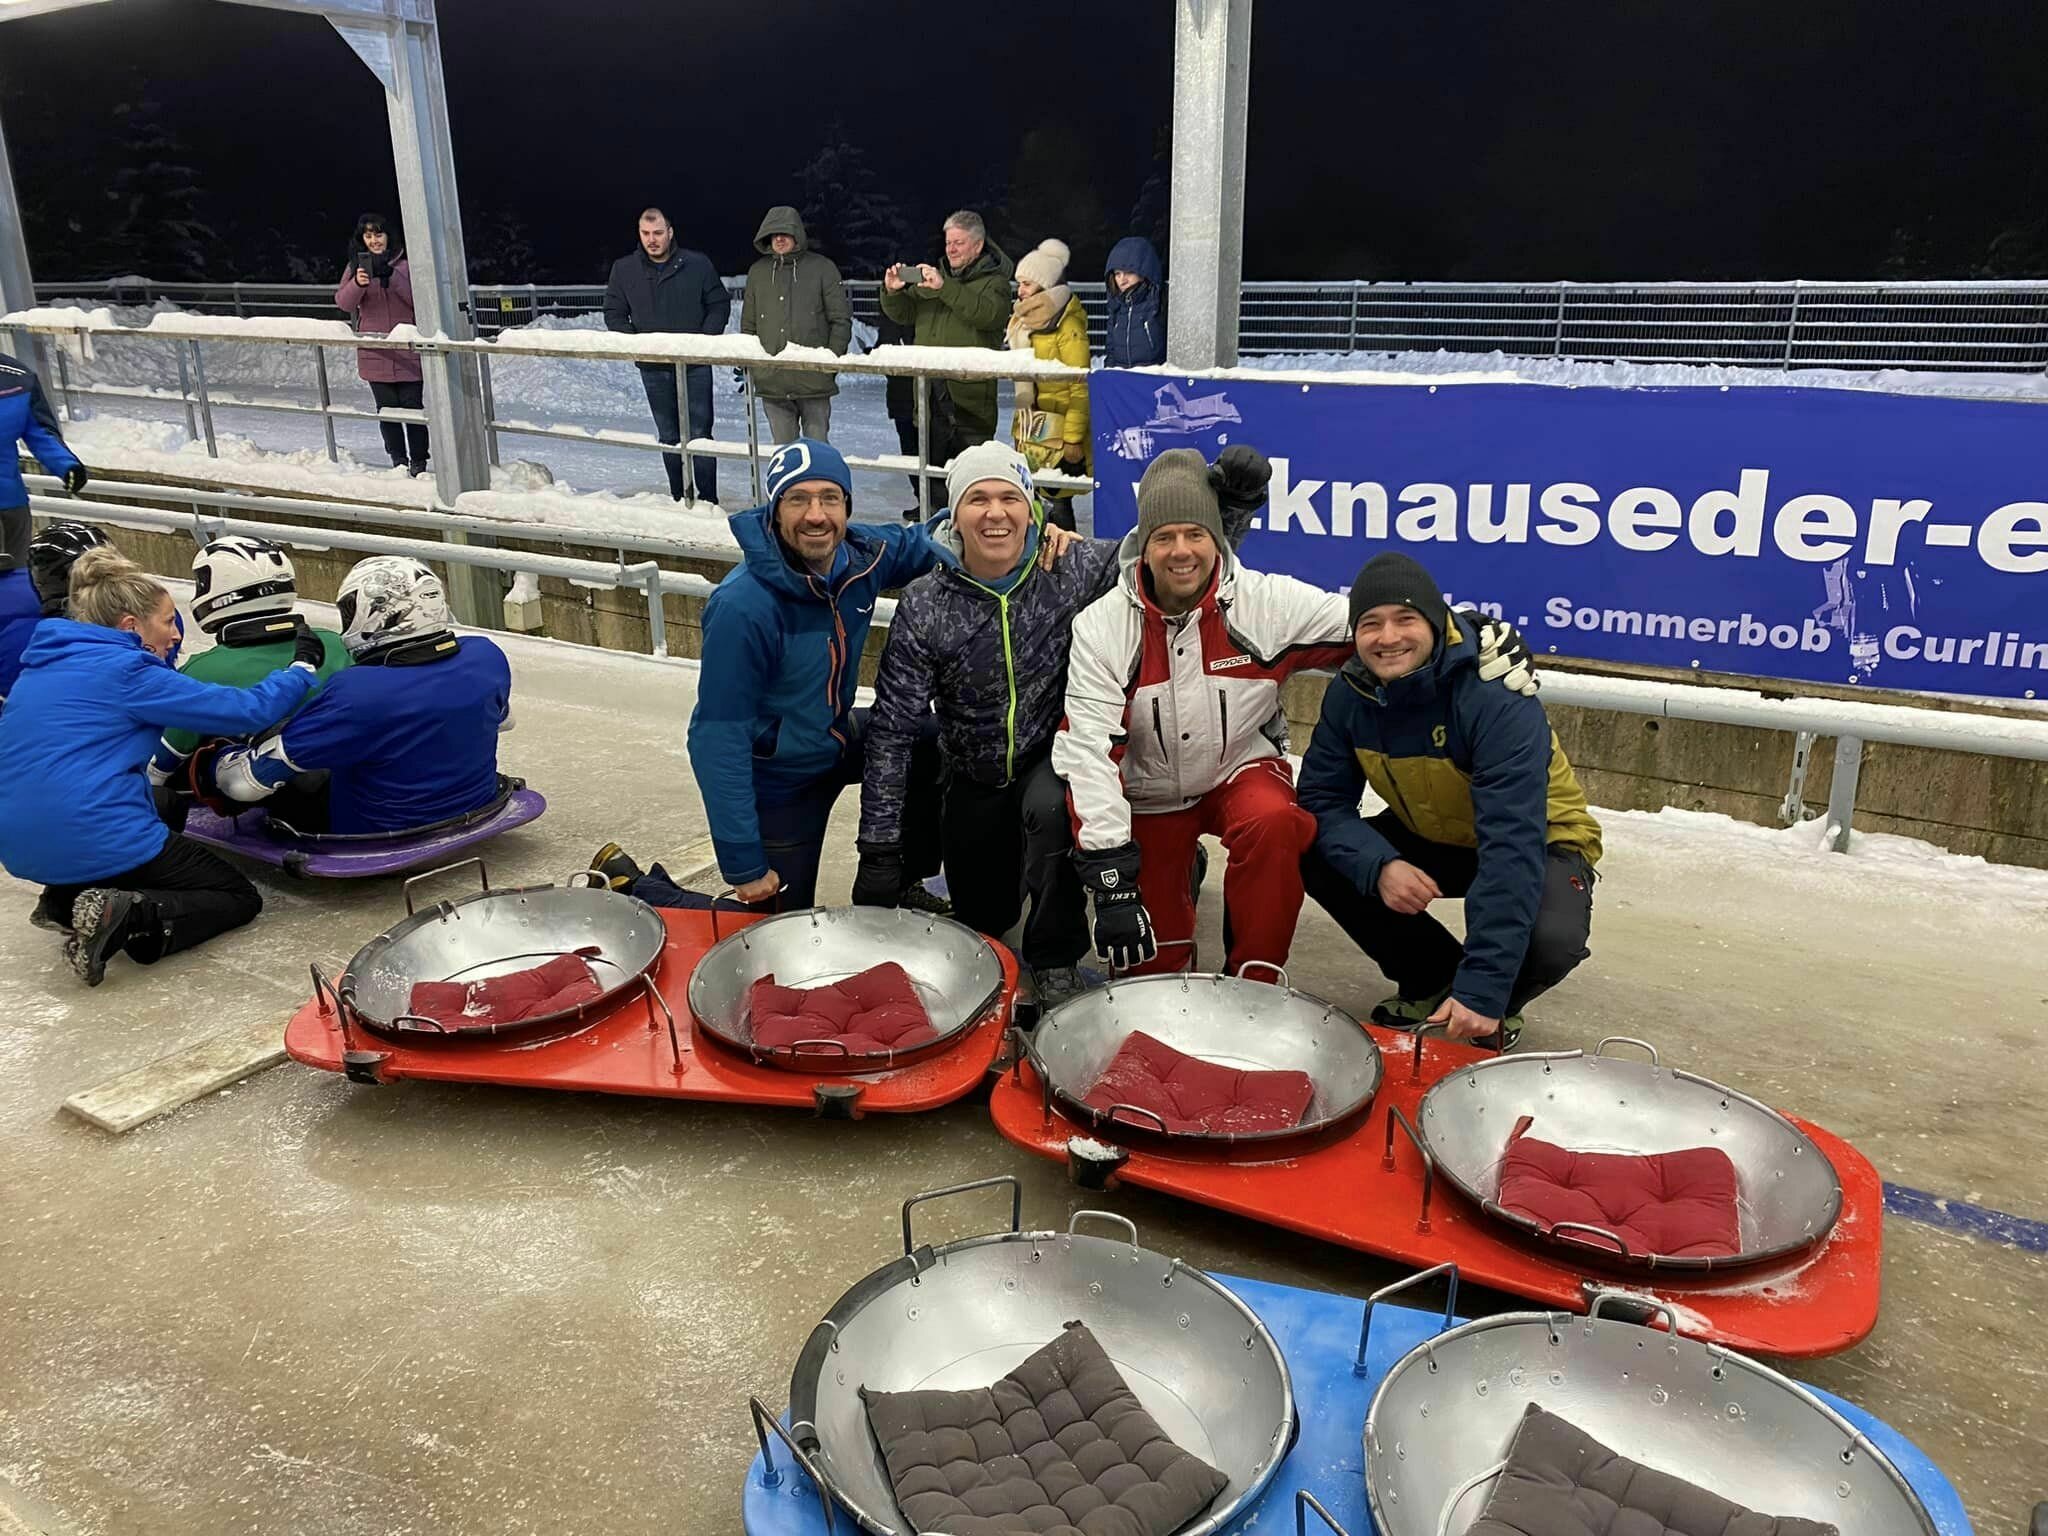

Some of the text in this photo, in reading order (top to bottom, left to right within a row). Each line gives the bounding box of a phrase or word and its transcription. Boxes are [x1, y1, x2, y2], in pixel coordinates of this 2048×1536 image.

[1131, 457, 2048, 573] .knauseder-e
[1544, 596, 1832, 653] Sommerbob
[1884, 625, 2048, 670] Curlin
[1212, 655, 1250, 669] SPYDER
[1111, 892, 1137, 901] LEKI
